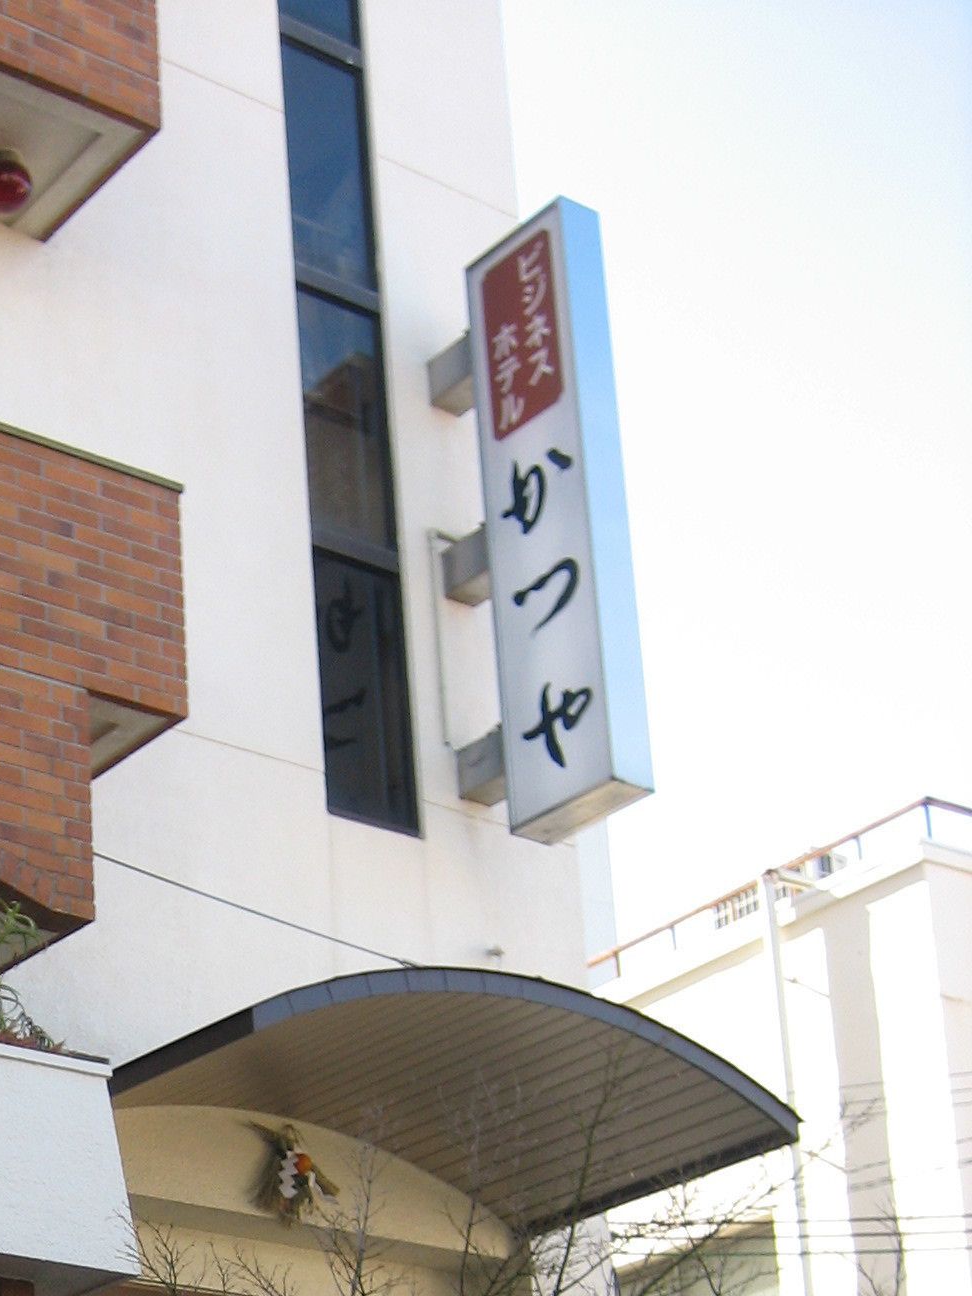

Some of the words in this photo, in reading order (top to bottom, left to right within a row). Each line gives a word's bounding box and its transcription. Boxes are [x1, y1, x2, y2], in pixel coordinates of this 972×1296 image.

[492, 322, 526, 431] ホテル
[517, 240, 556, 387] ビジネス
[501, 447, 594, 769] かつや
